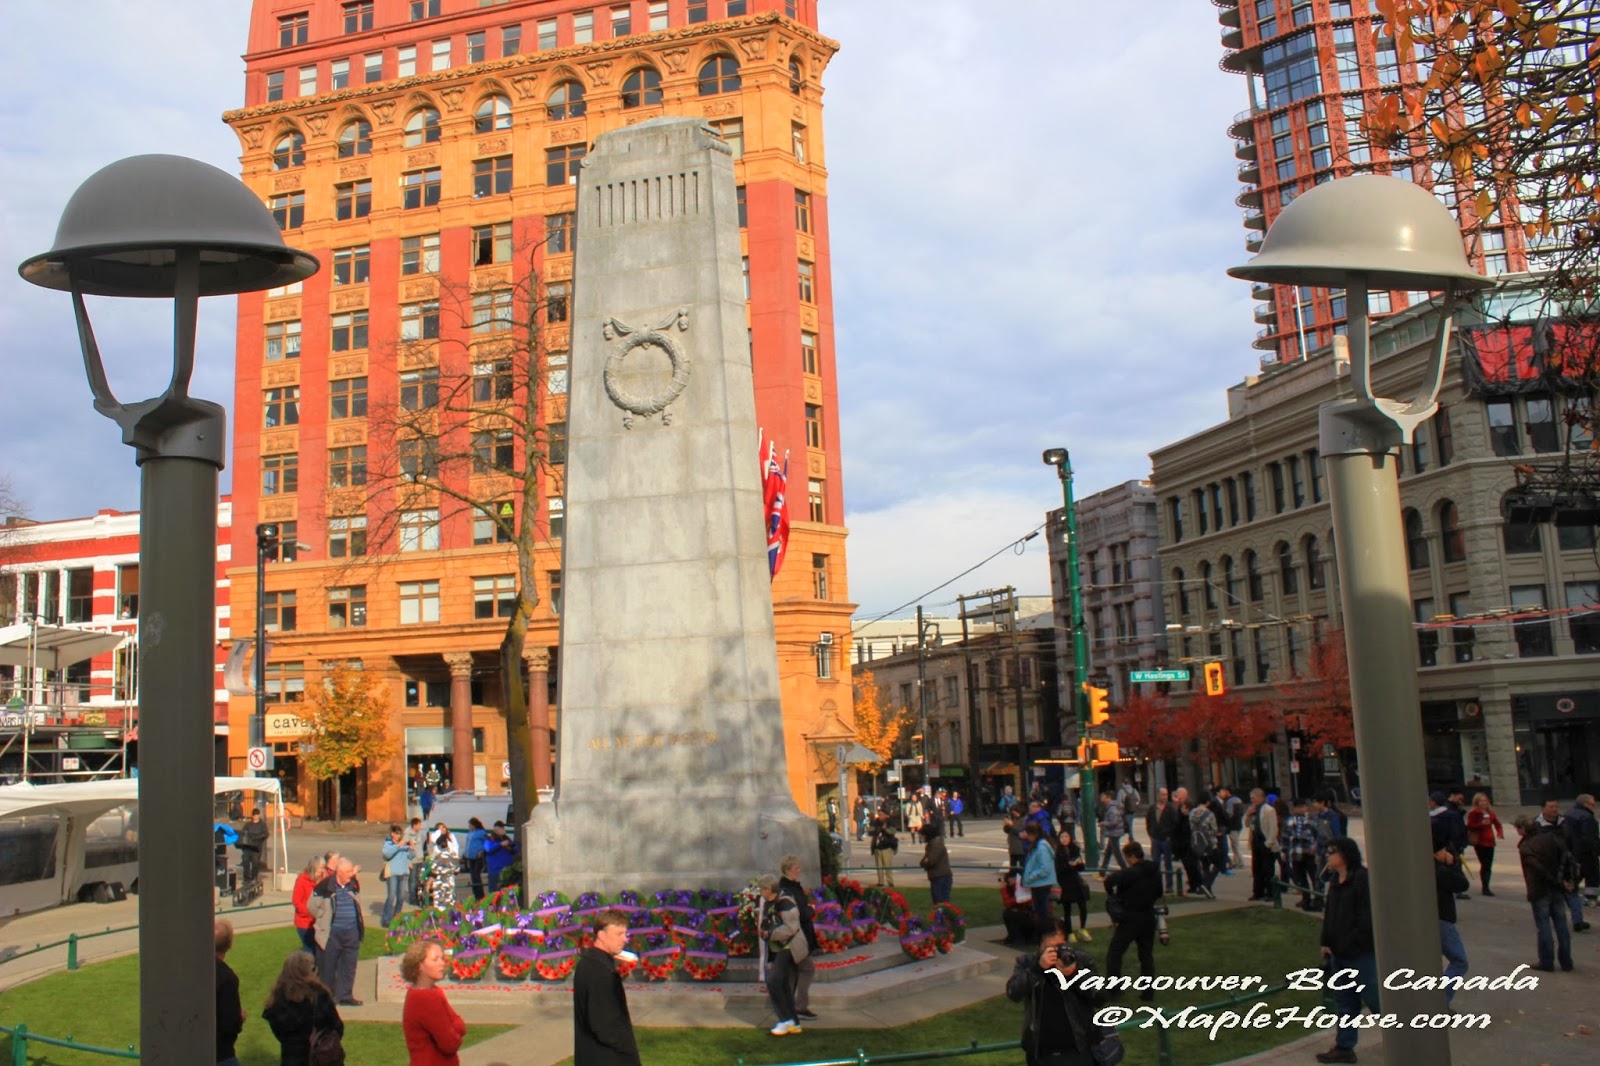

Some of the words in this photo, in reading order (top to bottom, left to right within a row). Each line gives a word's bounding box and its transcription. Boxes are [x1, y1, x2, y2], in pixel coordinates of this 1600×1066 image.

[1472, 328, 1539, 382] WE
[1135, 672, 1143, 680] W
[1145, 671, 1175, 680] Hastings
[1178, 671, 1186, 679] St
